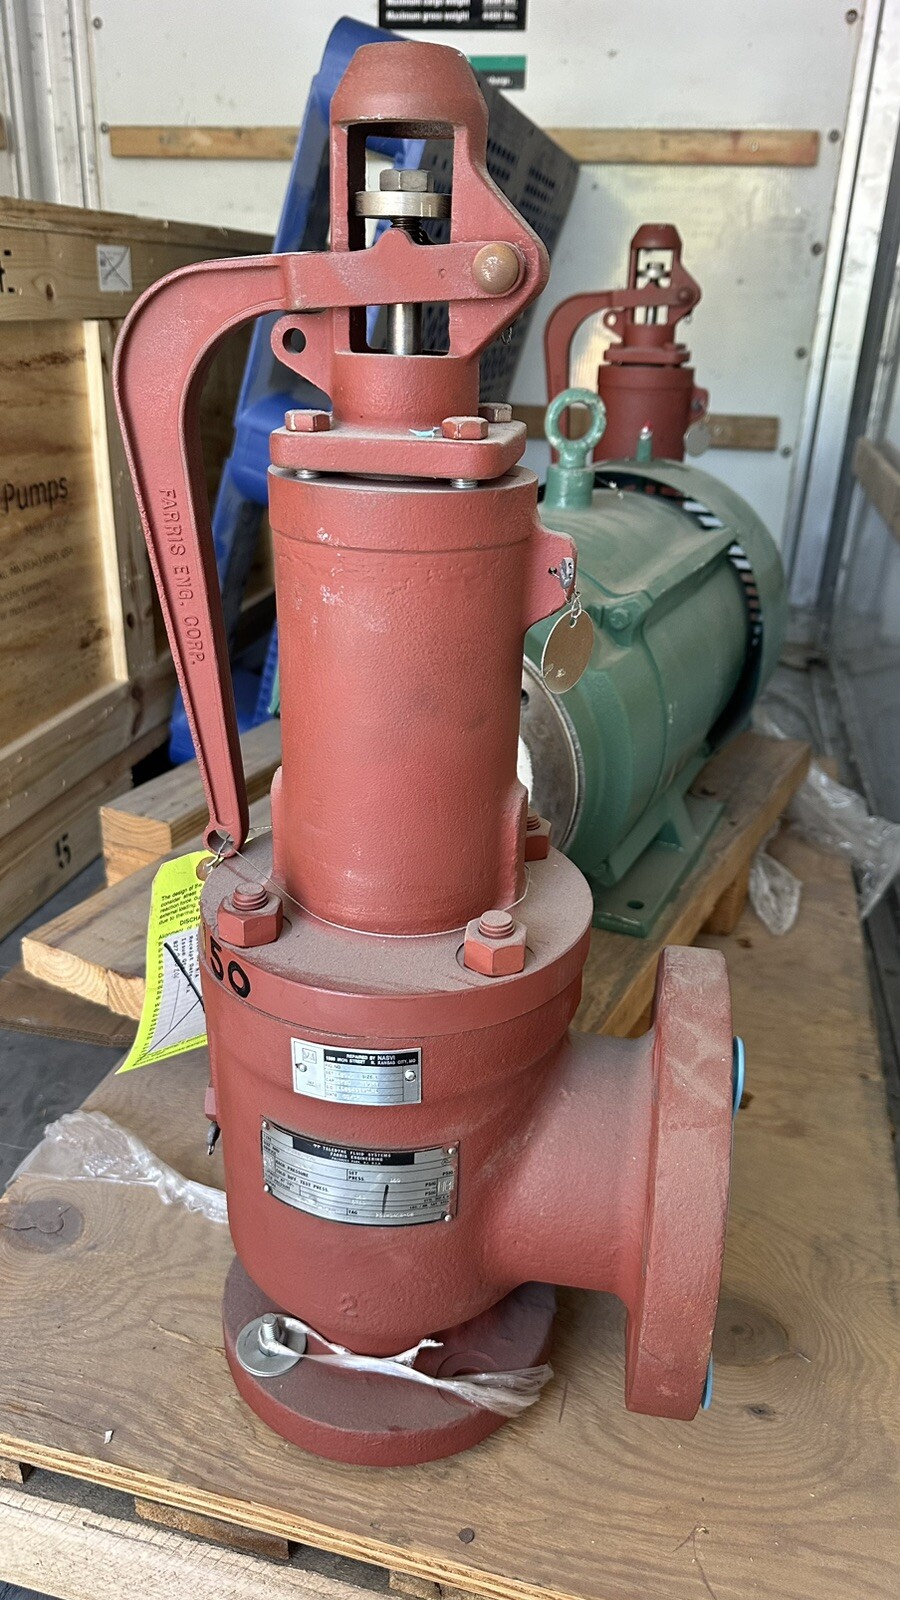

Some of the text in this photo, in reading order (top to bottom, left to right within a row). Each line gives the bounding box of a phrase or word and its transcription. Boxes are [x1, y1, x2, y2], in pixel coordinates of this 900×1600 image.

[4, 477, 69, 513] Pumps
[160, 489, 206, 666] FARRIS ENG. CORP.
[172, 888, 188, 898] design
[194, 882, 203, 890] the
[160, 902, 180, 913] reaction
[159, 908, 178, 919] external
[346, 1053, 368, 1061] REPAIRED
[322, 1145, 347, 1154] TELEDYNE
[330, 1151, 348, 1159] FARRIS
[287, 1165, 309, 1178] PRESSURE
